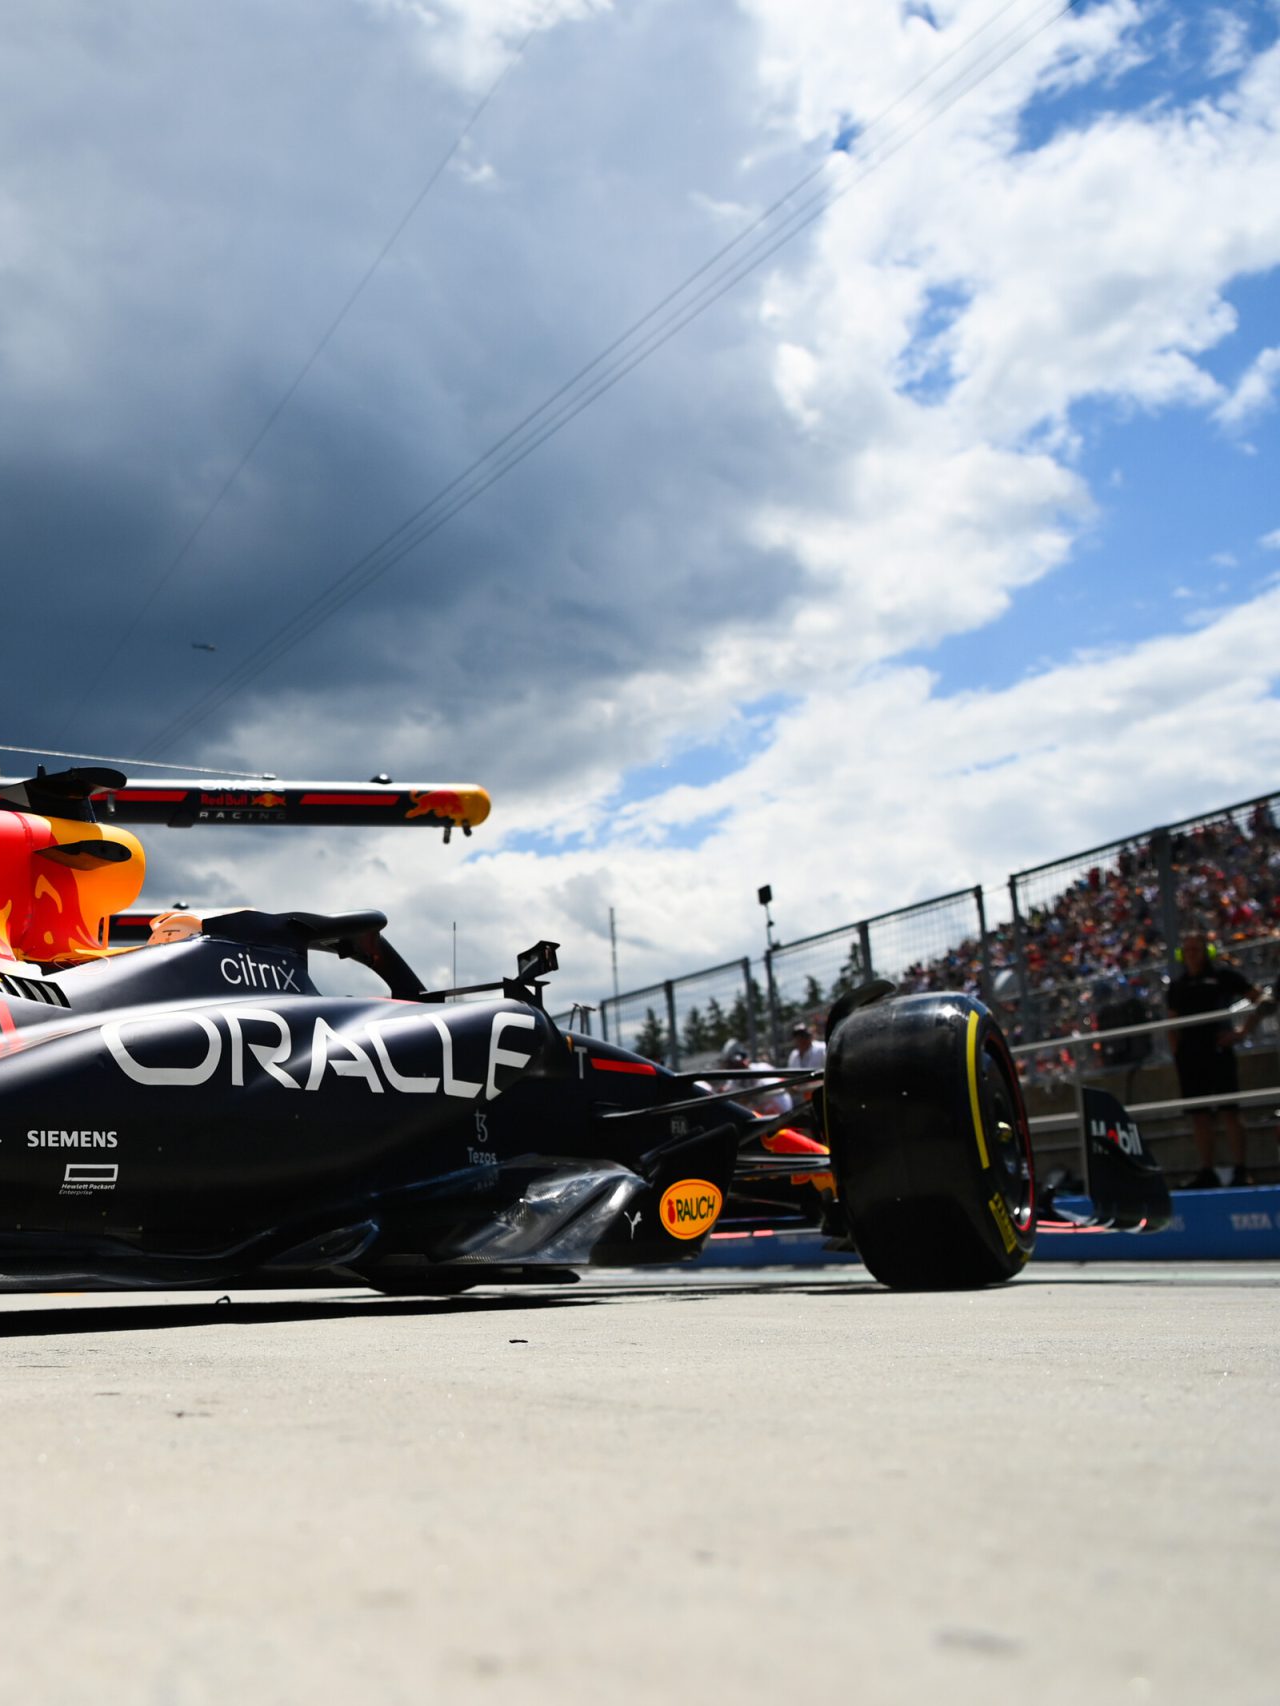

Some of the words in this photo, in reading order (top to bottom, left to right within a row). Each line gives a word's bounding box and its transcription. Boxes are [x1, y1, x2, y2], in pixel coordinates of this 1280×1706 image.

[220, 952, 301, 993] citrix
[100, 1008, 536, 1100] ORACLE
[27, 1129, 118, 1148] SIEMENS
[466, 1146, 498, 1166] Tezos
[675, 1195, 716, 1223] RAUCH
